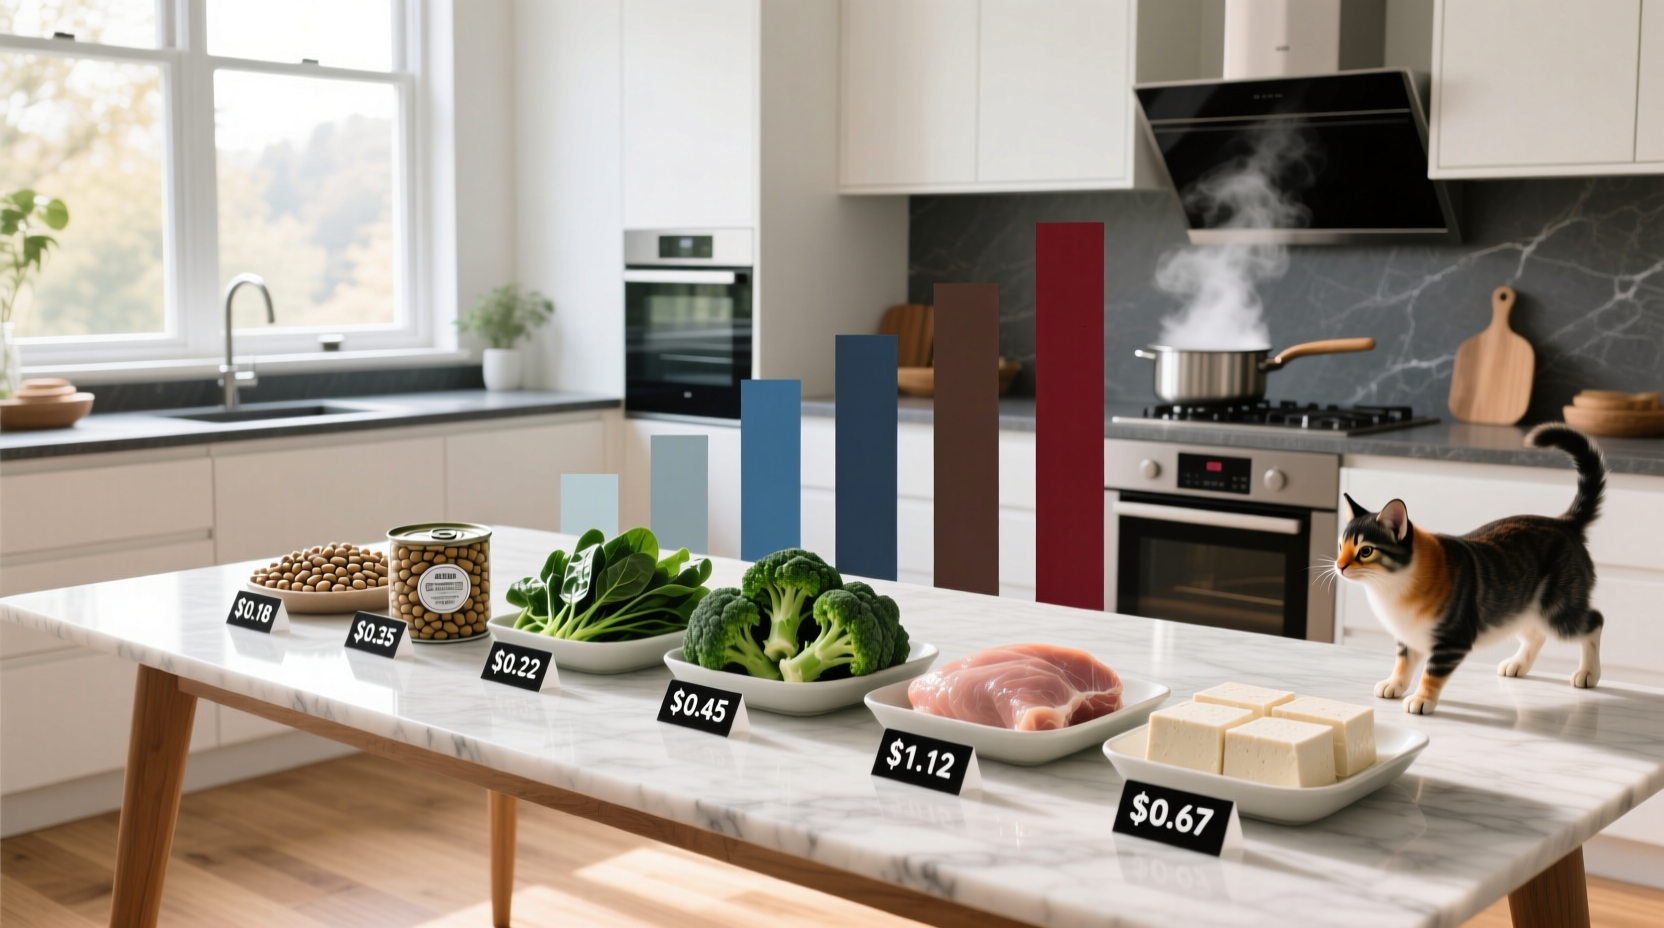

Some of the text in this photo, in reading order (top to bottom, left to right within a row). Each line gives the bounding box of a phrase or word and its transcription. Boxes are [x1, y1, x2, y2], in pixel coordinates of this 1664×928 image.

[235, 598, 273, 623] $0.18
[353, 620, 397, 648] $0.35
[491, 649, 541, 680] $0.22
[670, 688, 729, 723] $0.45
[886, 738, 955, 780] $1.12
[1130, 791, 1215, 836] $0.67
